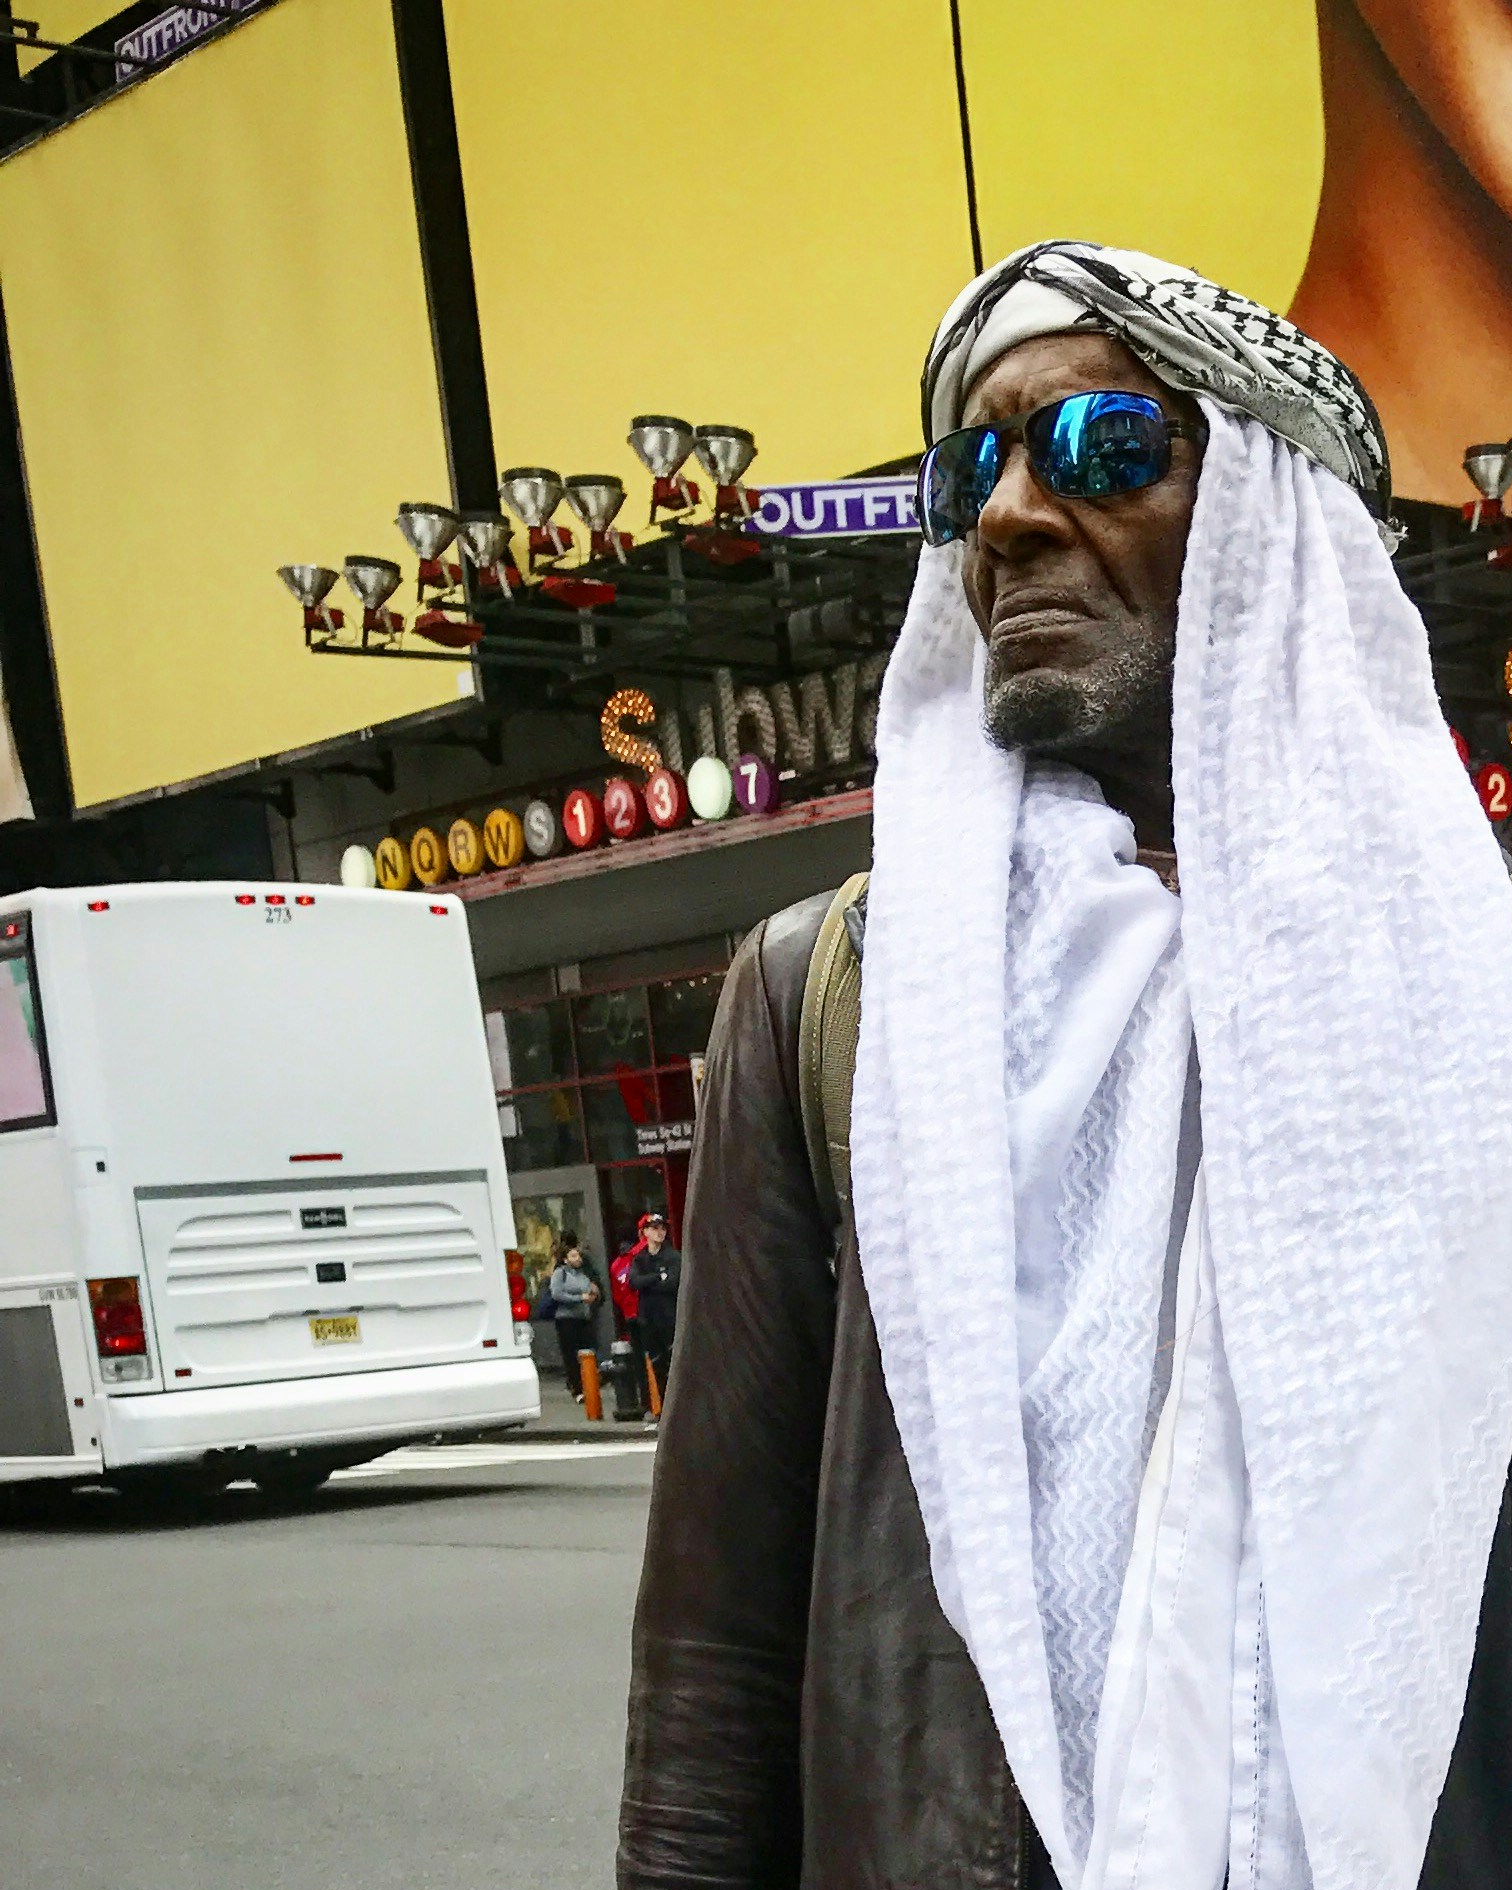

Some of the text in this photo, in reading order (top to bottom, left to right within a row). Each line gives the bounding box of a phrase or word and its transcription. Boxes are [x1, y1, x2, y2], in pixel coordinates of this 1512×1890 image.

[381, 762, 759, 882] N Q R W S 1 2 3 7
[1487, 773, 1509, 813] 2
